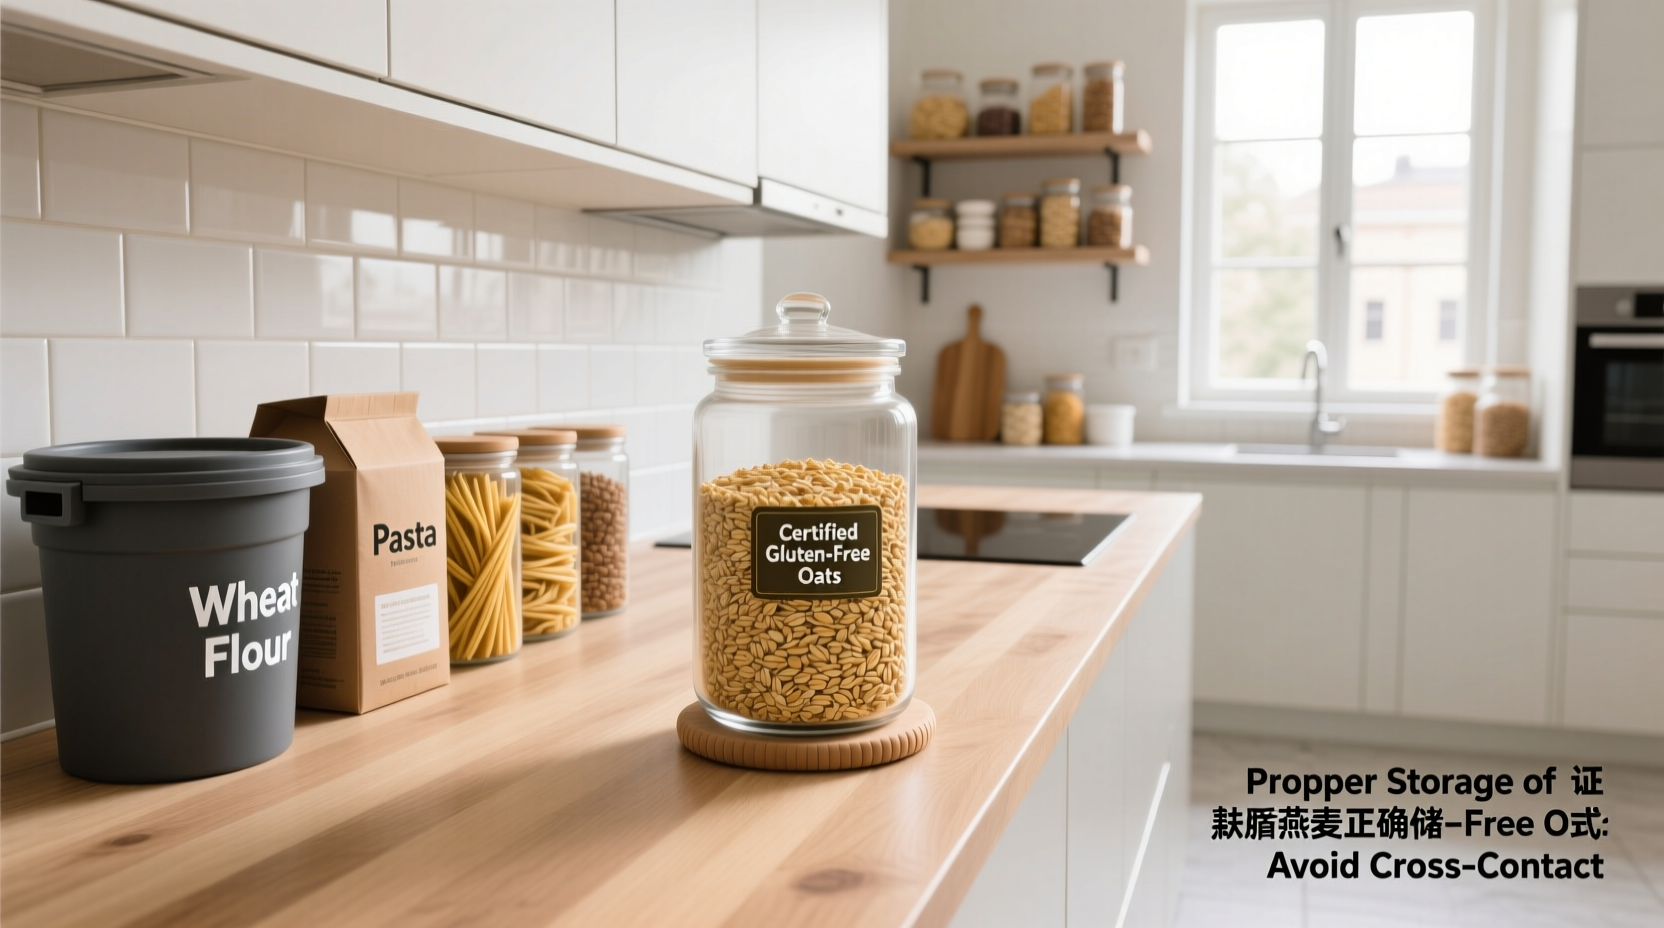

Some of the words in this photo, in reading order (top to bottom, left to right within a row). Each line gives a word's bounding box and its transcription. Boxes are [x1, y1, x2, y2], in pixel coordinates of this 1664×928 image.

[373, 522, 437, 556] Pasta
[779, 522, 858, 541] Certified
[765, 544, 871, 562] Gluten-Free
[798, 566, 841, 584] Oats
[189, 572, 299, 628] Wheat
[205, 630, 292, 678] Flour
